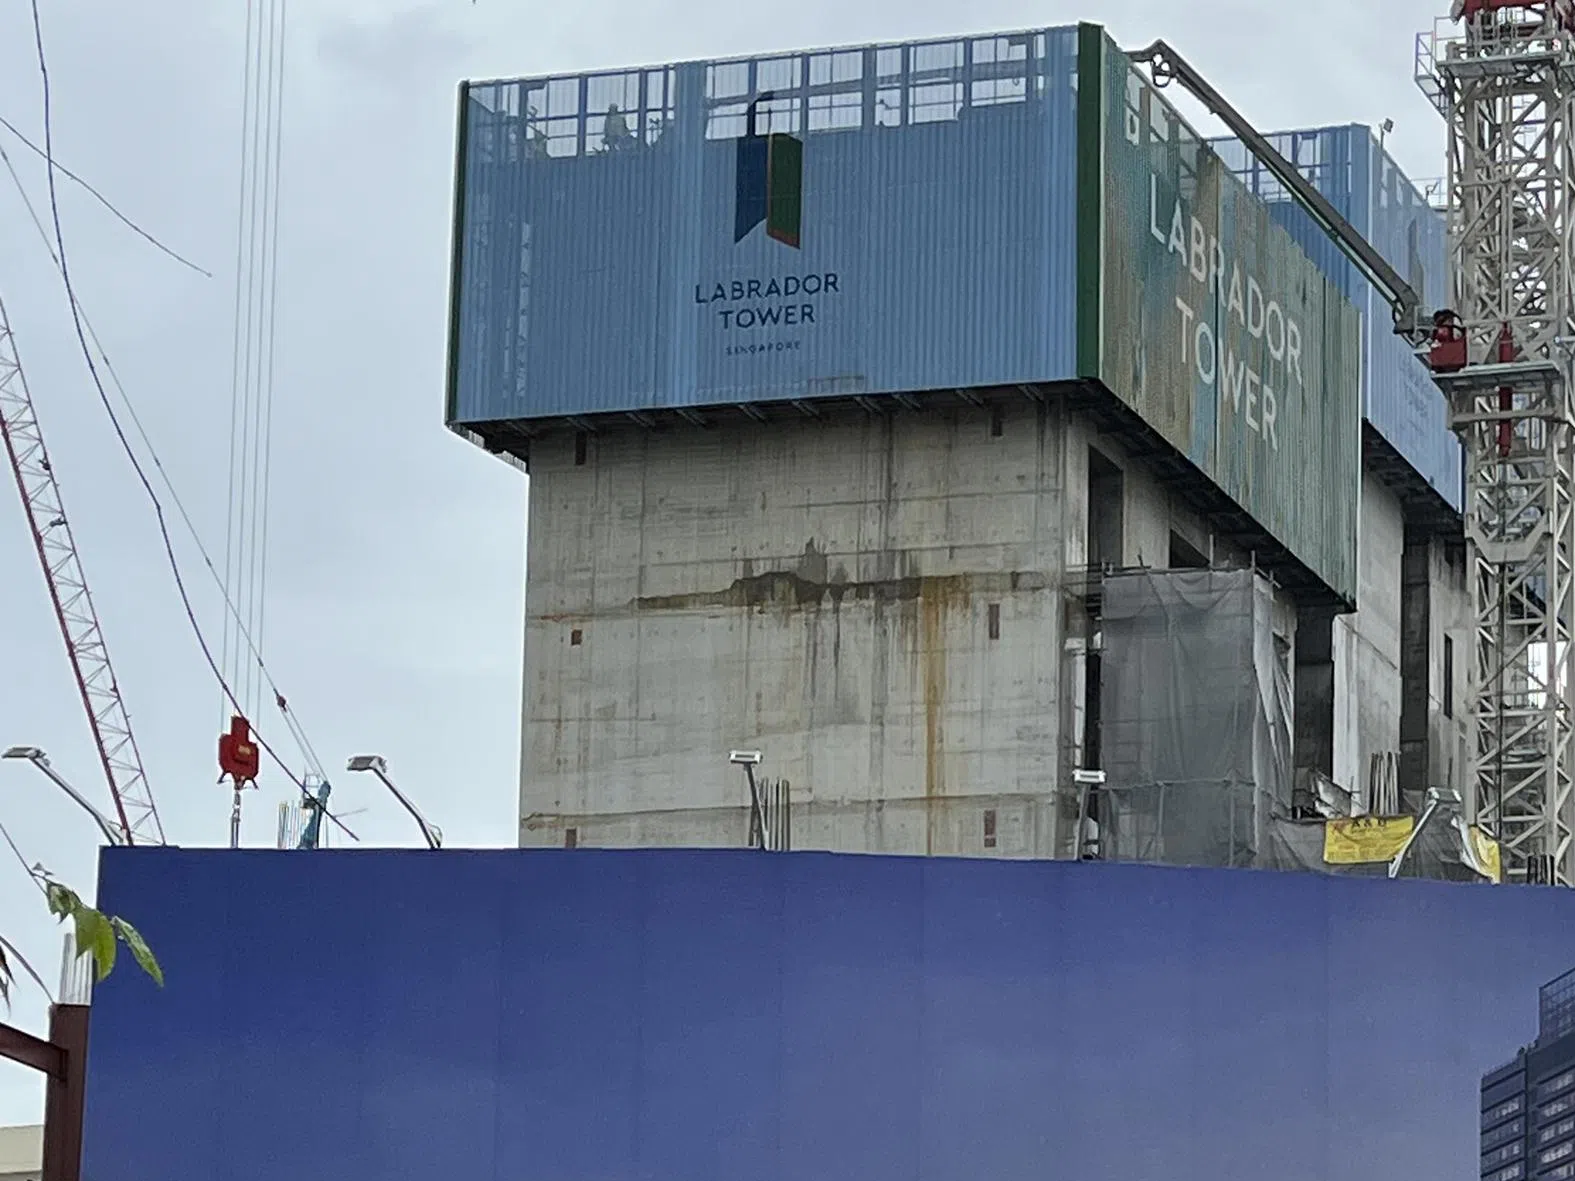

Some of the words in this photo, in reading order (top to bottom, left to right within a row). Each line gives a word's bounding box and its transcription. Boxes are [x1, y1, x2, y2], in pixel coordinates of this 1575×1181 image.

[695, 273, 839, 303] LABRADOR
[1151, 173, 1302, 385] LABRADOR
[719, 304, 815, 329] TOWER
[726, 341, 800, 356] SINGAPORE
[1175, 296, 1278, 451] TOWER
